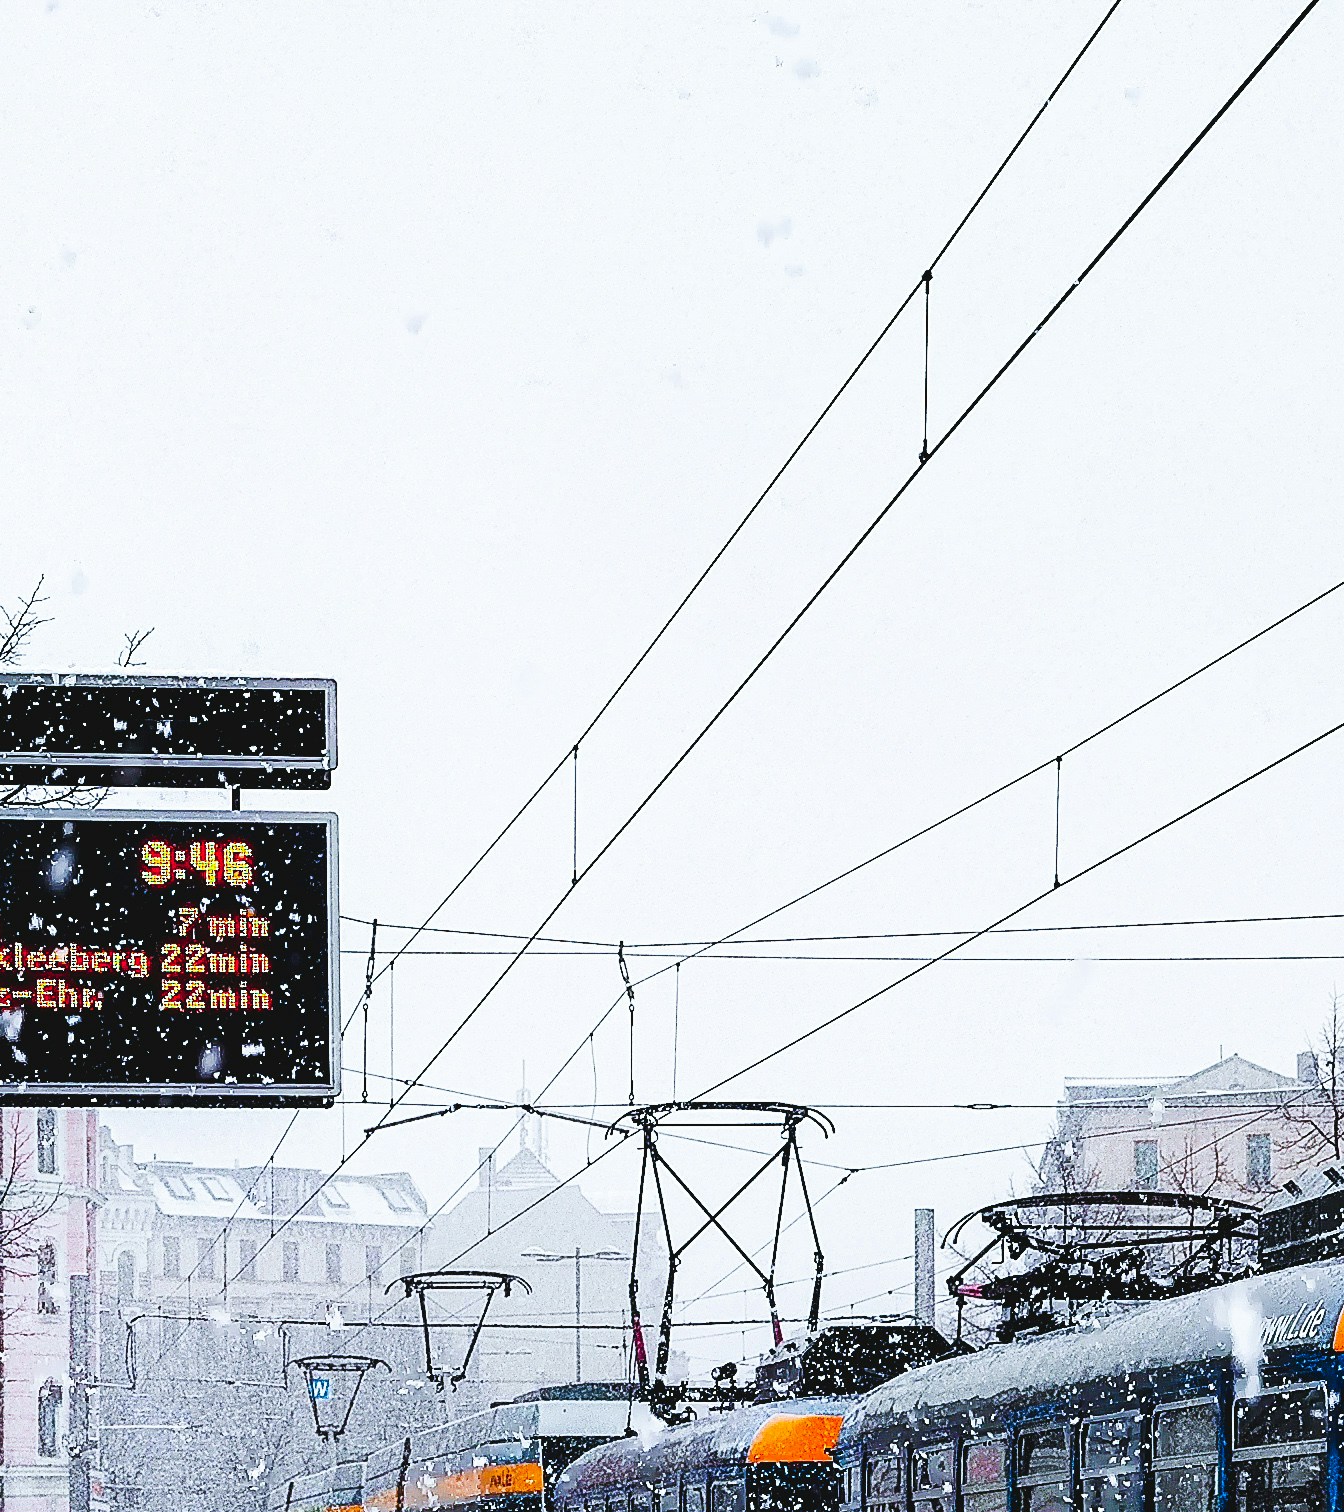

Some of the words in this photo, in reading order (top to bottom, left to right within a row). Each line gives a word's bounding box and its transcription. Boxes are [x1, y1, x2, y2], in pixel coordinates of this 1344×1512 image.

[142, 841, 253, 886] 9:46
[178, 906, 200, 937] 7
[207, 907, 270, 938] min
